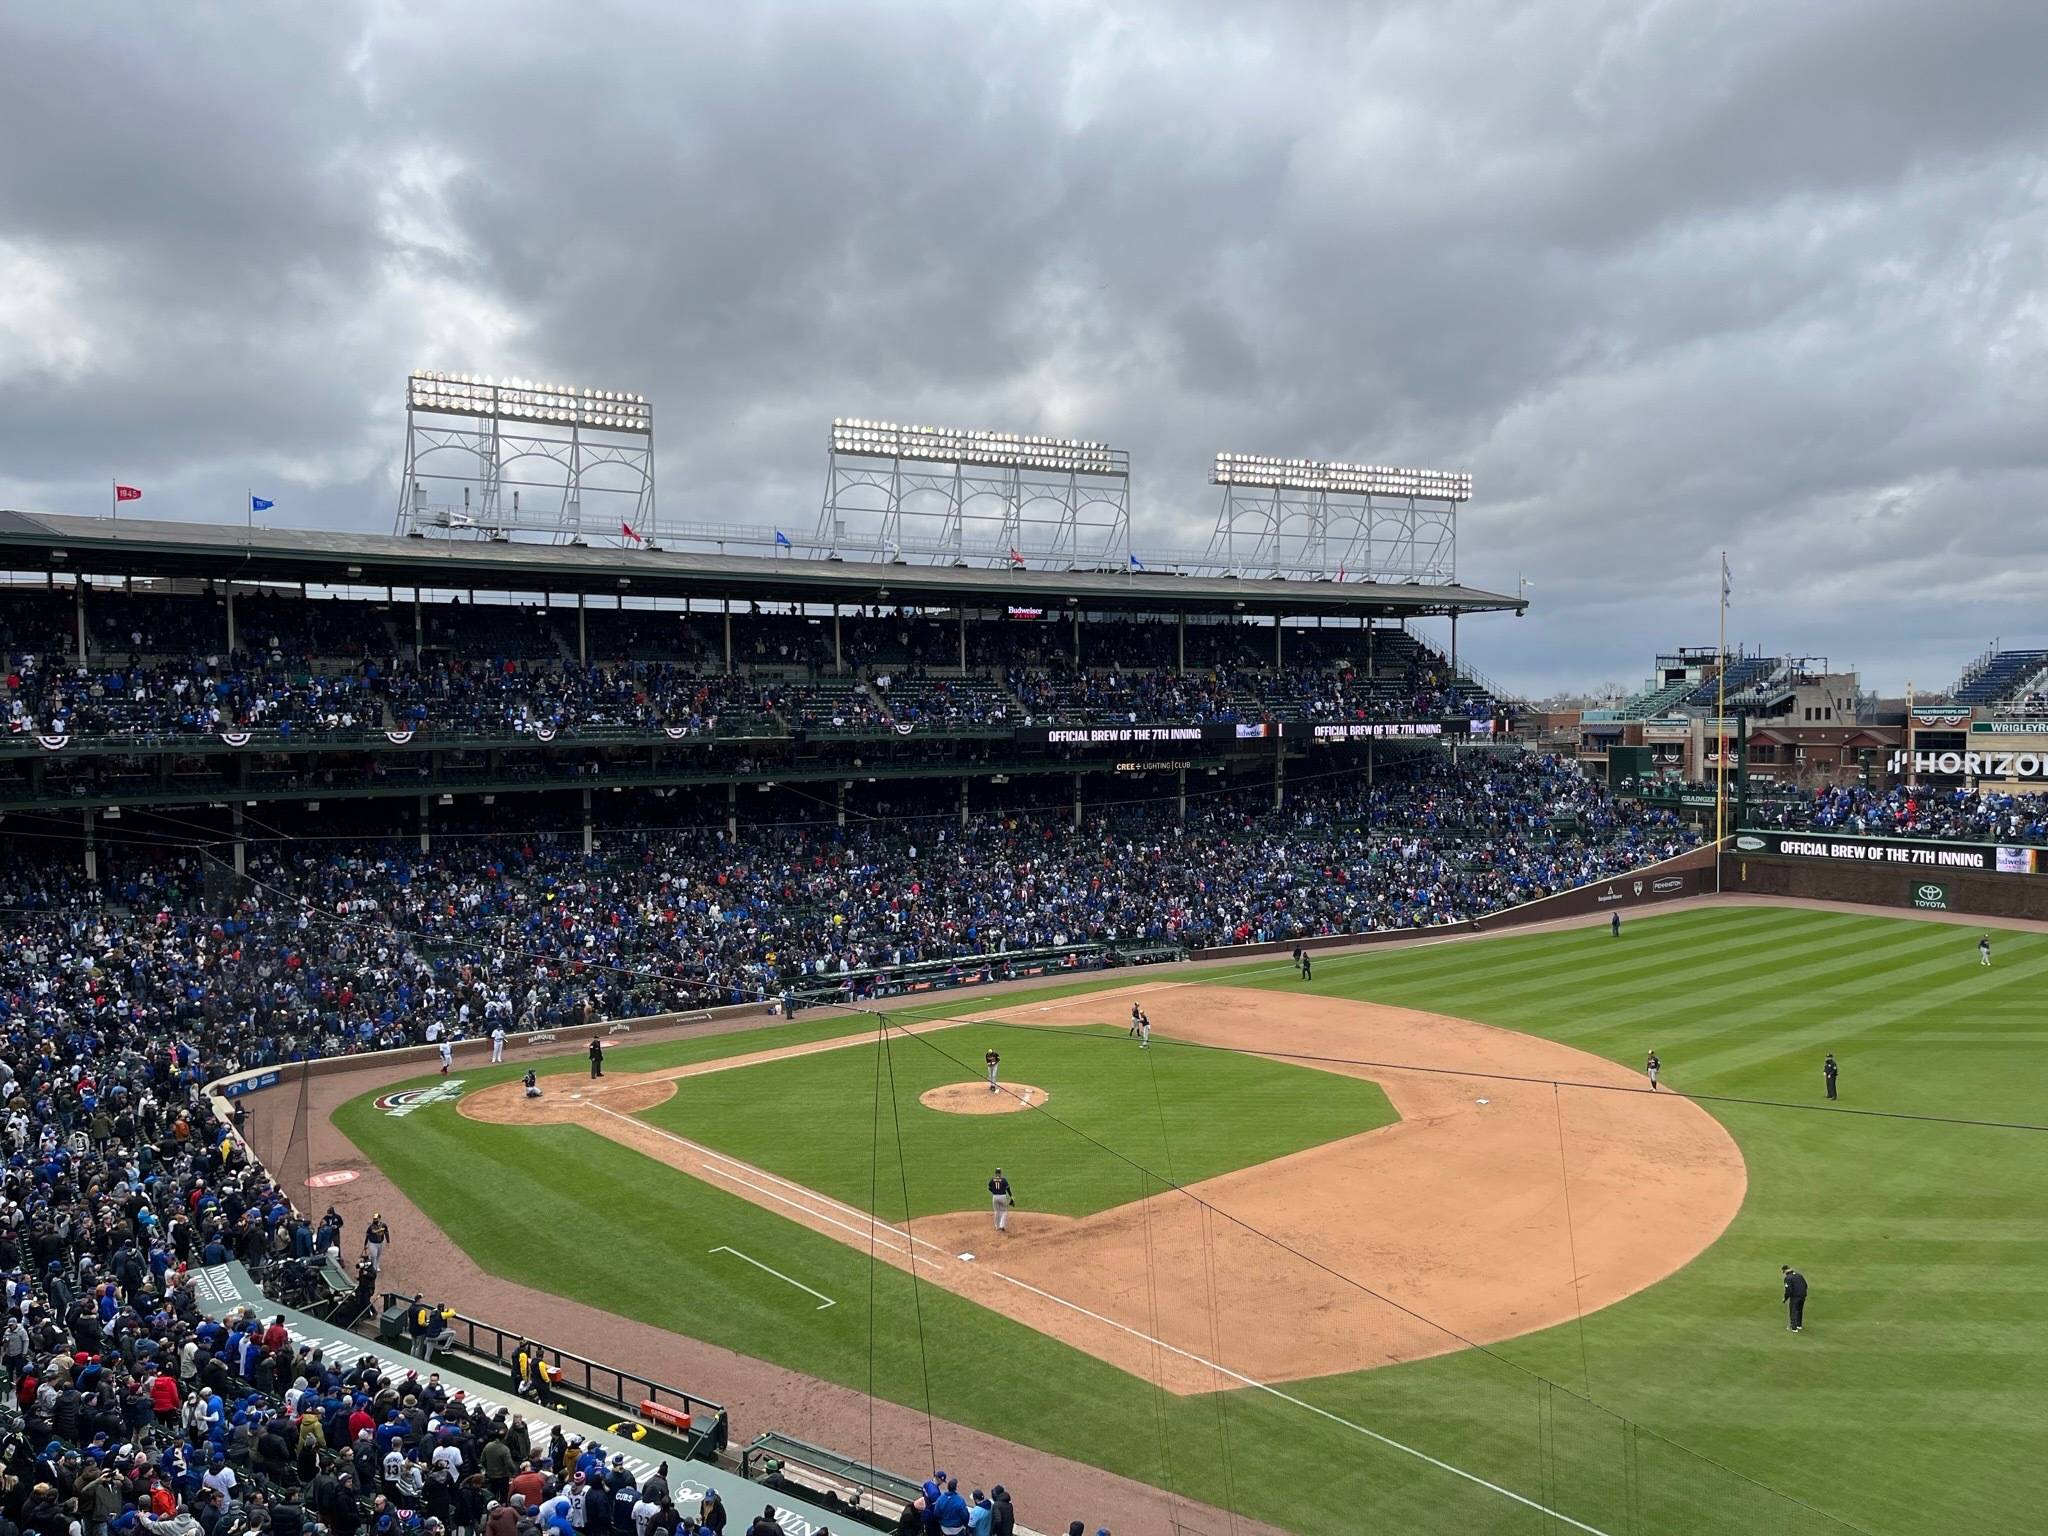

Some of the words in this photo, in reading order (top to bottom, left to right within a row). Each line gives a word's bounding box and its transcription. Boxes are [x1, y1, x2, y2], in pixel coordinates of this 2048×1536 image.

[1008, 605, 1043, 615] Budweiser
[1314, 725, 1348, 736] OFFICIAL
[1349, 725, 1372, 736] BREW
[1373, 724, 1383, 735] OF
[1385, 724, 1399, 735] THE
[1400, 724, 1415, 735] 7TH
[1415, 723, 1441, 734] INNING
[1991, 723, 2048, 732] WRIGLEYR
[1048, 730, 1089, 742] OFFICIAL
[1091, 729, 1118, 741] BREW
[1119, 729, 1132, 741] OF
[1133, 729, 1150, 740] THE
[1152, 729, 1169, 740] 7TH
[1170, 728, 1202, 740] INNING
[1116, 763, 1136, 771] CREE
[1142, 761, 1171, 770] LIGHTING
[1174, 761, 1191, 769] CLUB
[1915, 751, 2048, 776] HORIZO
[1780, 841, 1829, 857] OFFICIAL
[1831, 844, 1865, 859] BREW
[1867, 847, 1884, 860] OF
[1885, 847, 1909, 862] THE
[1911, 849, 1935, 864] 7TH
[1938, 851, 1983, 868] INNING
[1914, 900, 1946, 909] TOYOTA
[528, 1034, 556, 1044] MARQUEE
[206, 1263, 242, 1302] WINTRUST
[320, 1340, 360, 1359] THE
[386, 1464, 399, 1475] 13
[615, 1492, 634, 1503] CUBS
